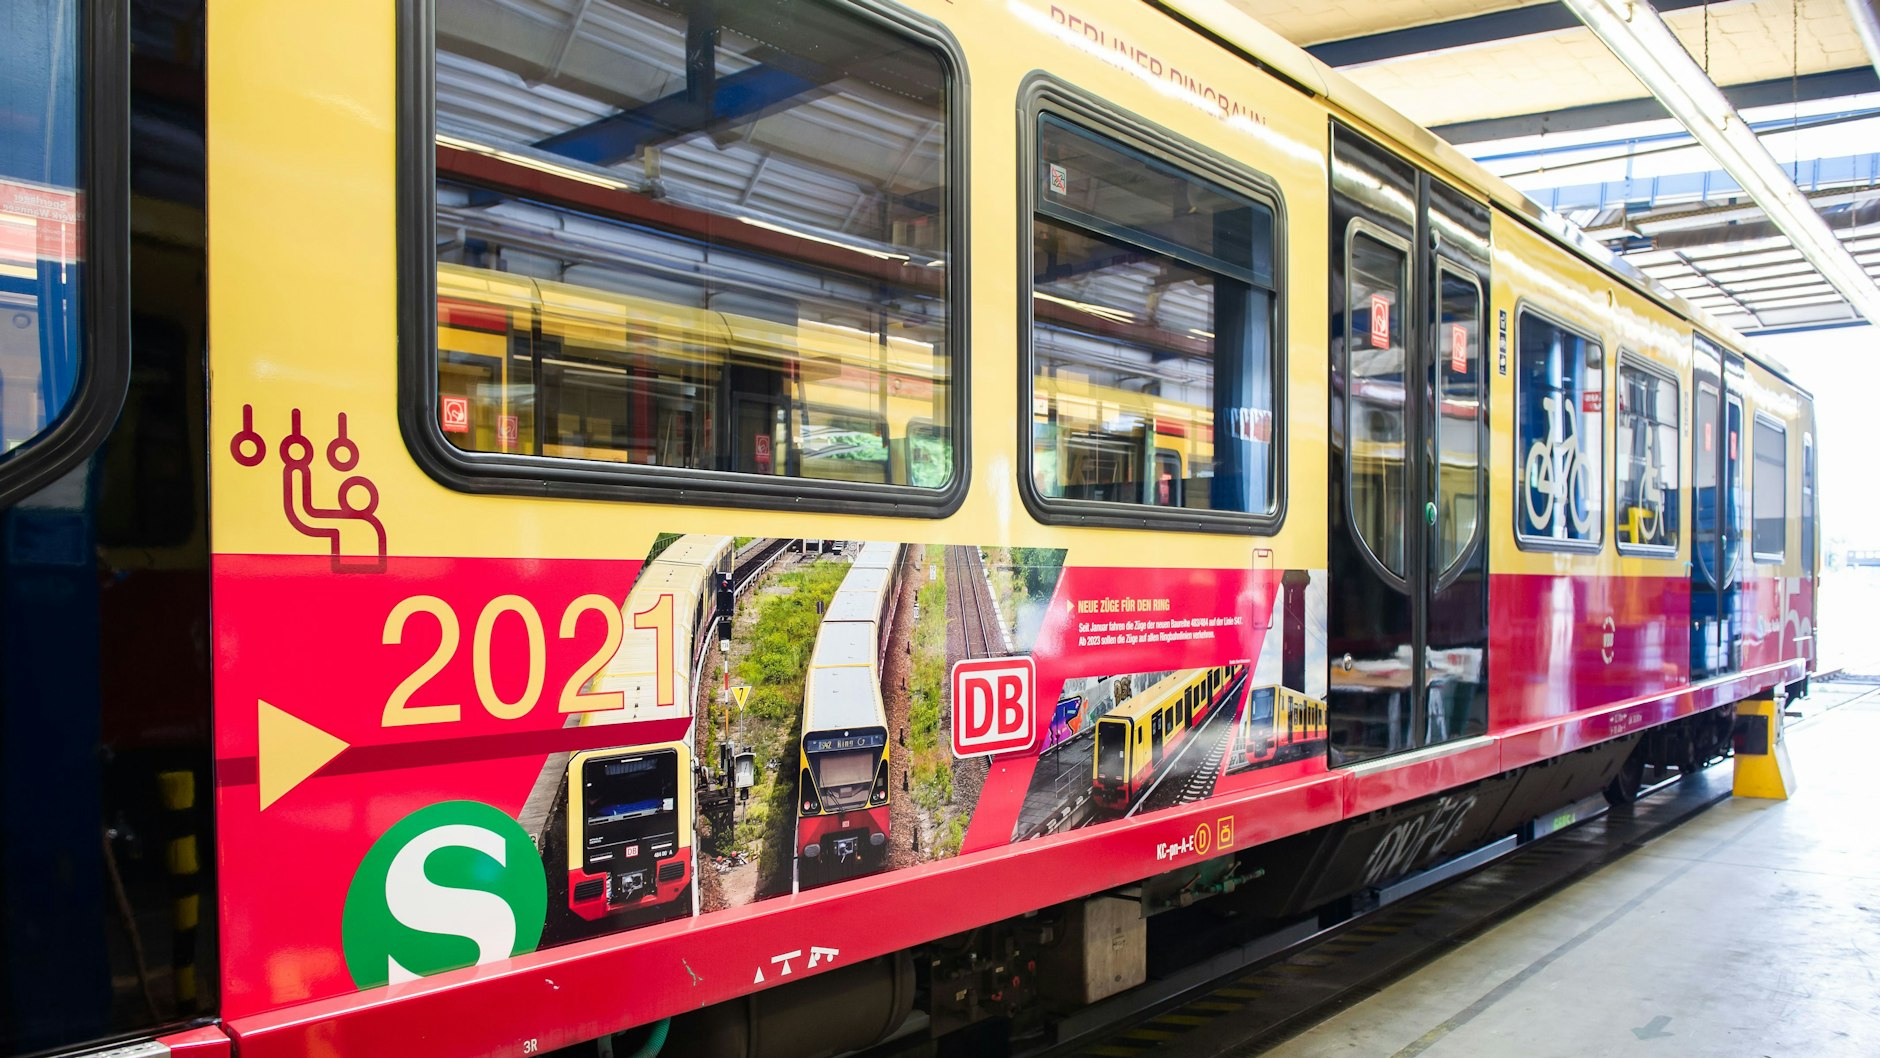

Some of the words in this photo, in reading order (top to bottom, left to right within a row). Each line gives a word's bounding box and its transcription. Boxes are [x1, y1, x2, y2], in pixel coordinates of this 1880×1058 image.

[1078, 599, 1098, 613] NEUE
[1100, 597, 1119, 613] ZÜGE
[1121, 597, 1136, 612] FÜR
[1137, 599, 1151, 612] DEN
[1153, 599, 1170, 611] RING
[1078, 622, 1090, 632] Seit
[1090, 622, 1108, 632] Januar
[1109, 621, 1125, 631] fahren
[1126, 620, 1134, 630] die
[1134, 620, 1147, 632] Züge
[1147, 620, 1155, 629] der
[1156, 621, 1170, 629] neuen
[1171, 618, 1190, 628] Baureihe
[1078, 635, 1087, 646] Ab
[1087, 635, 1100, 646] 2023
[1101, 635, 1116, 645] sollen
[1117, 634, 1125, 644] die
[1126, 634, 1138, 645] Züge
[1138, 633, 1147, 643] auf
[1147, 632, 1159, 642] allen
[381, 594, 676, 728] 2021
[739, 687, 745, 700] 7
[965, 674, 1024, 740] DB
[627, 847, 637, 856] DB
[1156, 834, 1194, 861] KC-pn-A-E
[384, 824, 516, 985] S
[523, 1038, 538, 1054] 3R
